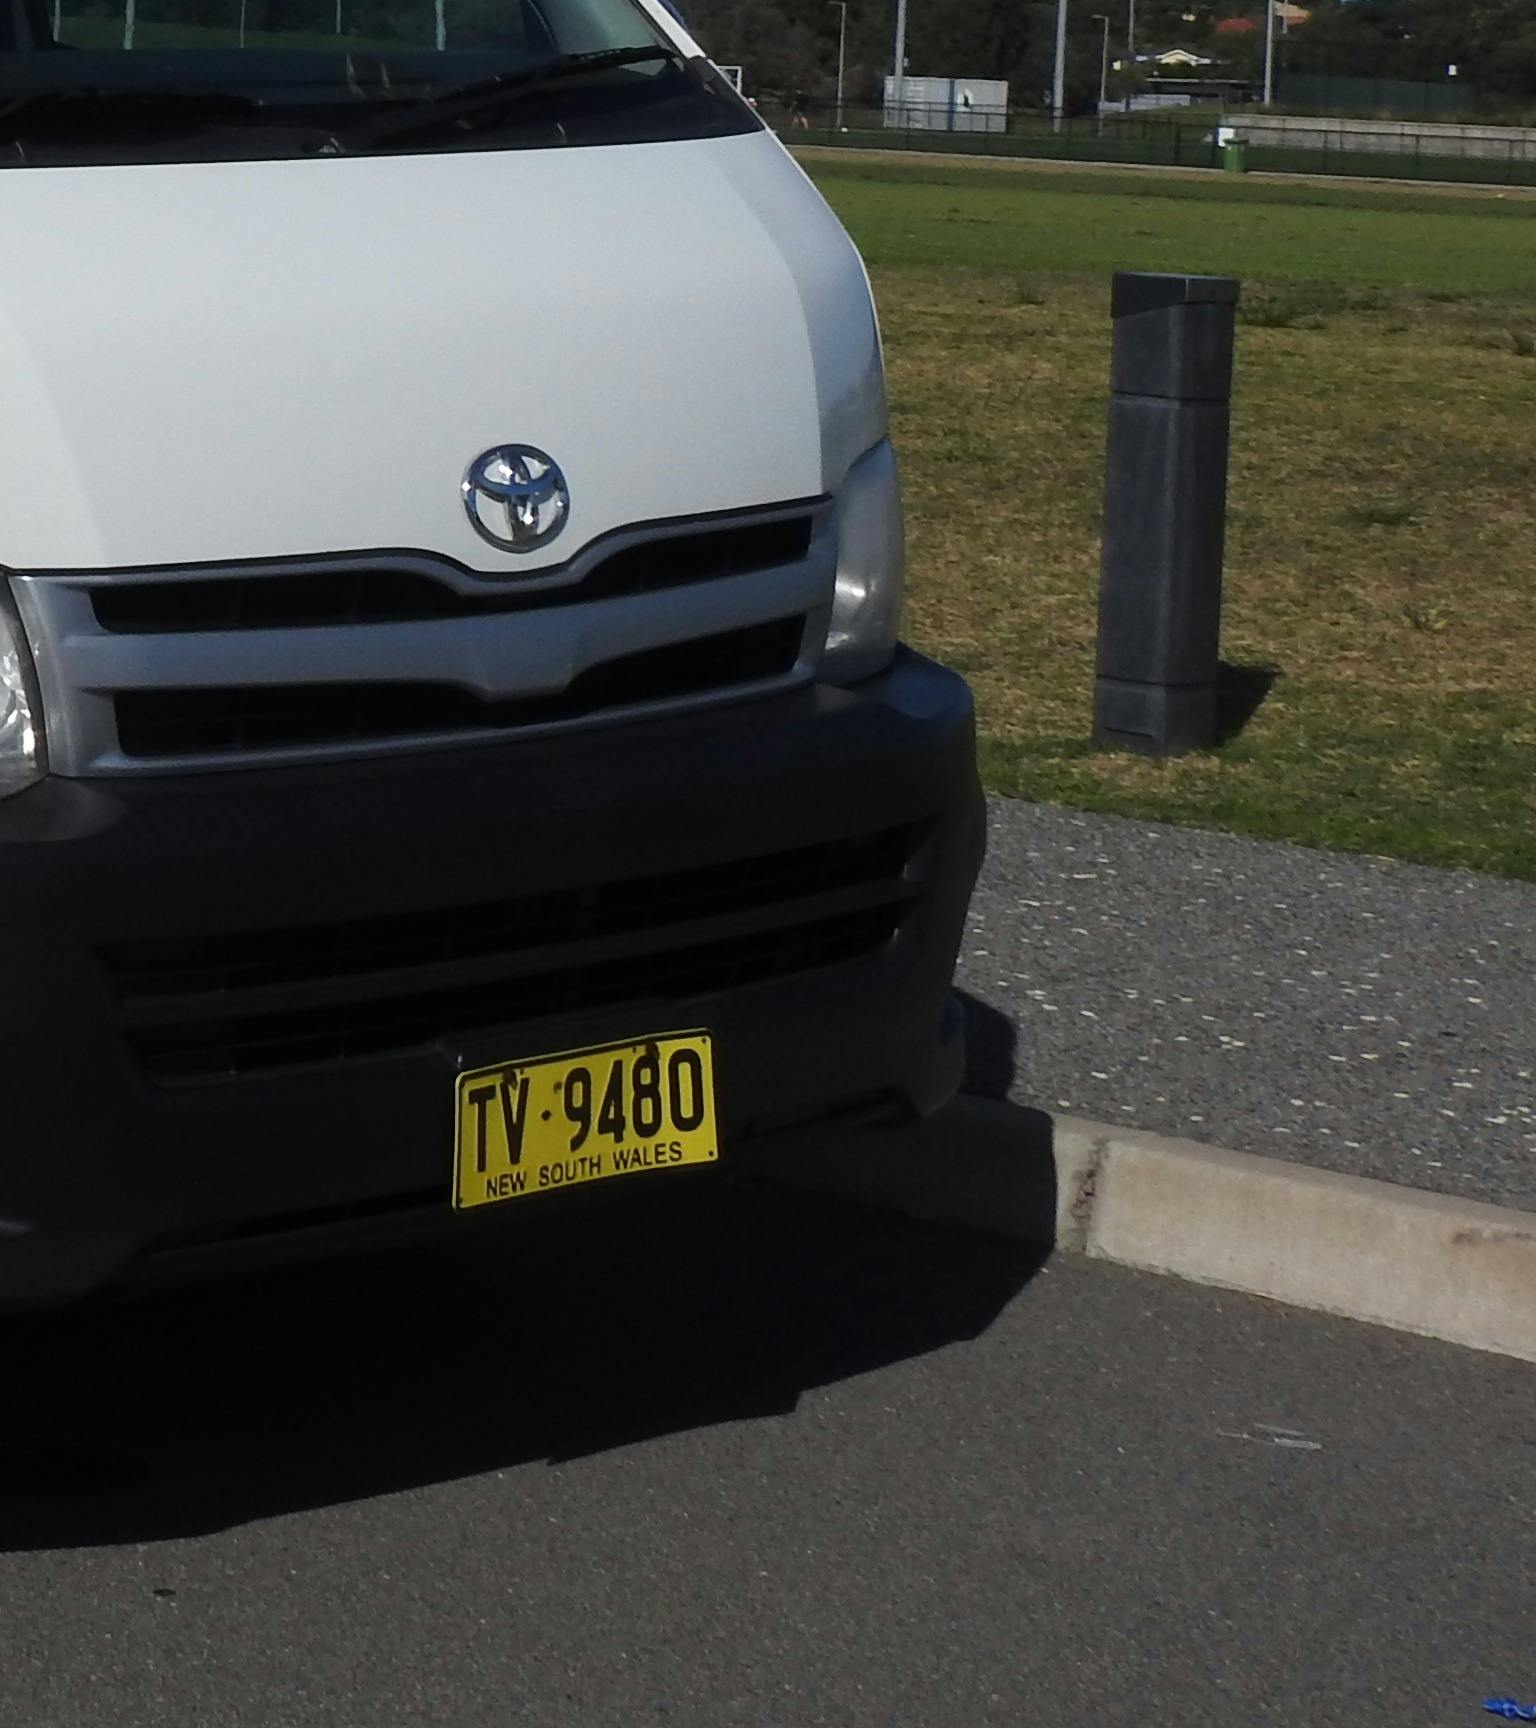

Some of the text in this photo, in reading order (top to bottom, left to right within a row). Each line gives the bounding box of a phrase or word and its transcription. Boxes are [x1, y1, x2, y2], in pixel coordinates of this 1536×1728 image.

[486, 1140, 684, 1199] NEW SOUTH WALES
